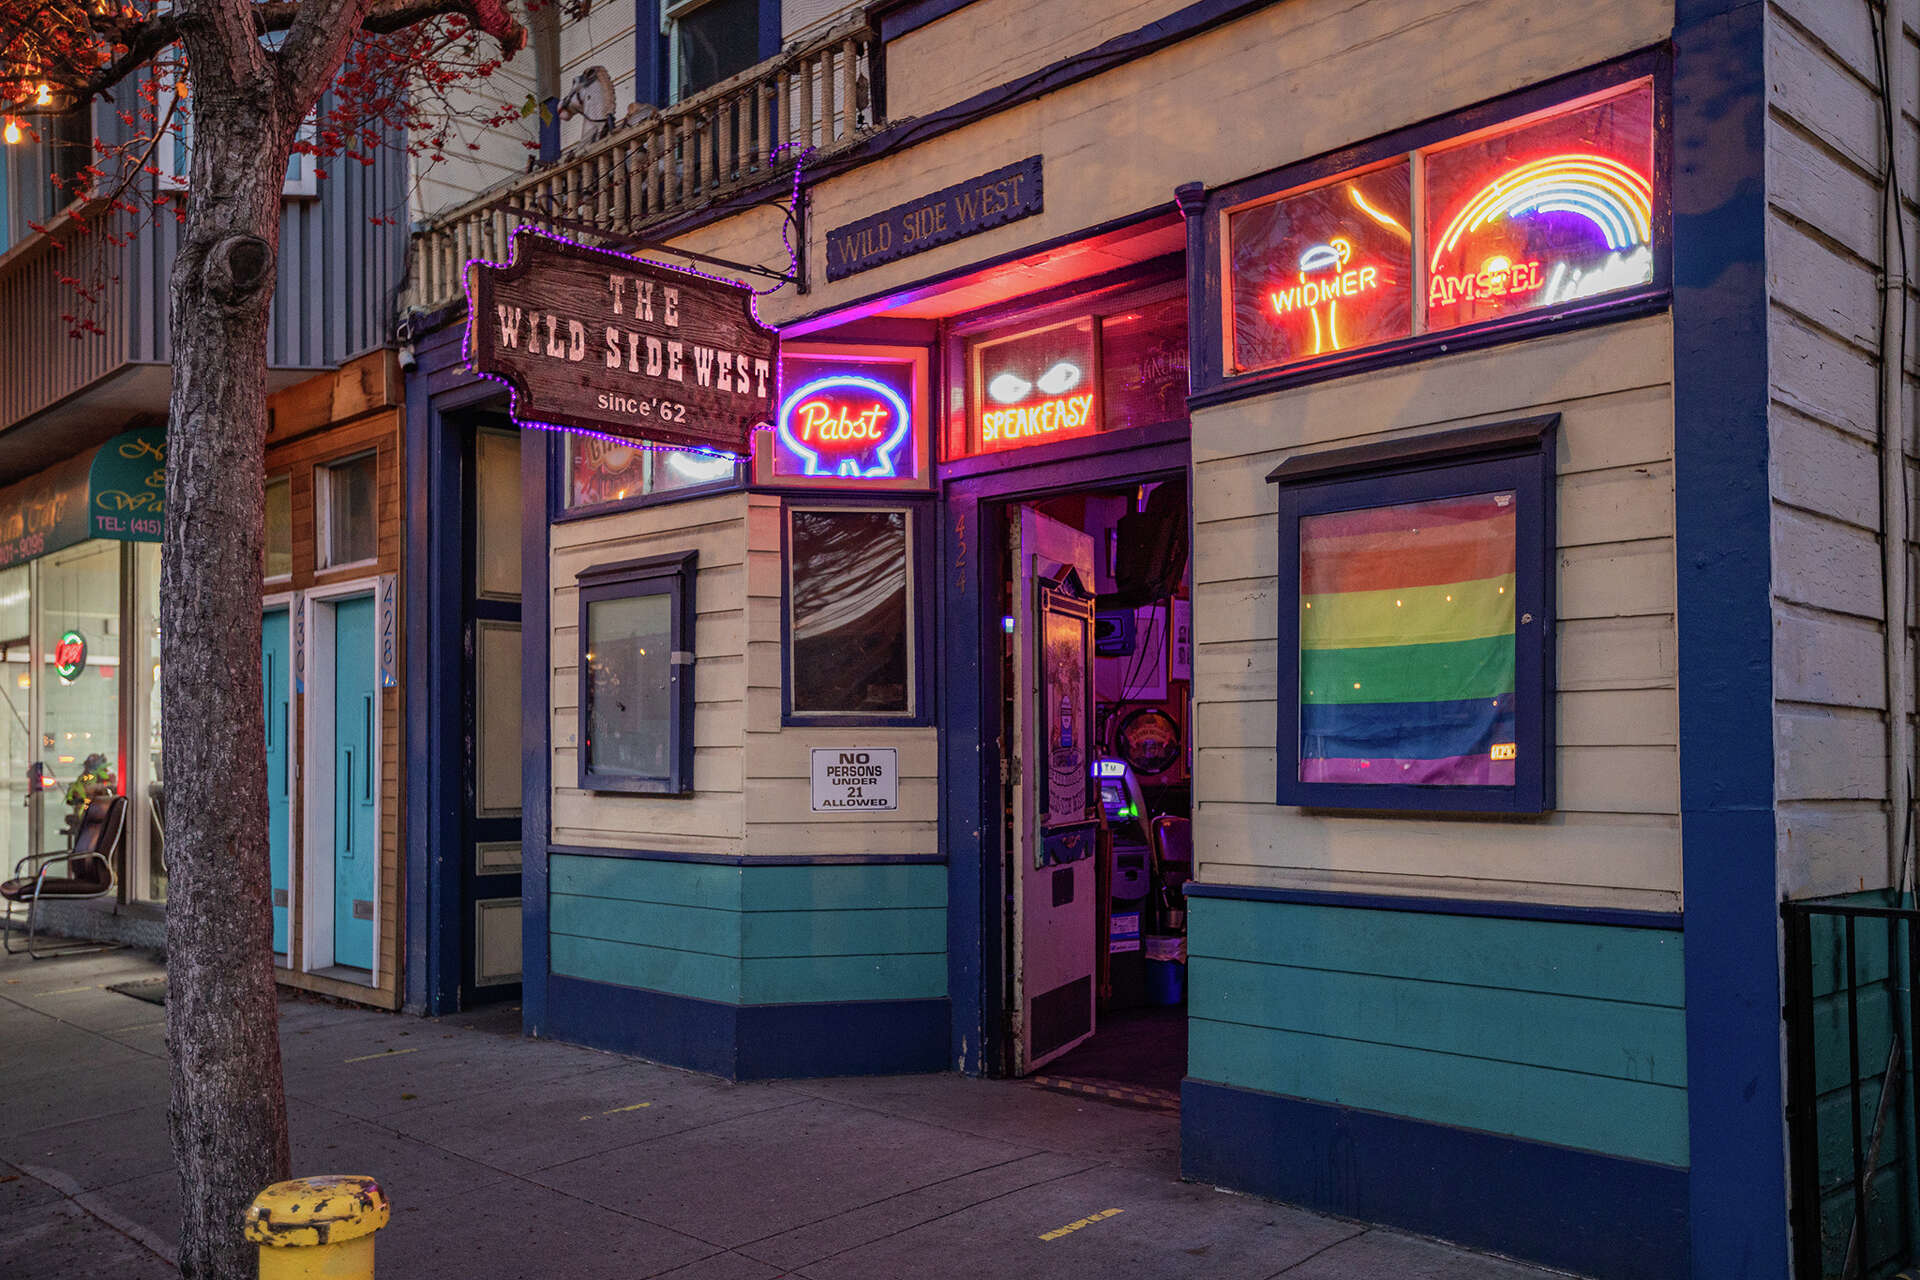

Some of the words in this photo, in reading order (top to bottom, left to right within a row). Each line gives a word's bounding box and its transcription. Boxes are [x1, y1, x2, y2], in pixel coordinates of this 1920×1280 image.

[837, 221, 892, 264] WILD
[902, 203, 948, 244] SIDE
[955, 174, 1024, 225] WEST
[609, 274, 680, 327] THE
[1271, 265, 1377, 315] WIDMER
[1429, 261, 1545, 307] AMSTEL
[497, 303, 586, 362] WILD
[605, 325, 684, 382] SIDE
[693, 345, 770, 399] WEST
[798, 401, 889, 441] Pabst
[982, 393, 1093, 441] SPEAKEASY
[96, 515, 126, 532] TEL:
[130, 517, 161, 536] (415)
[954, 512, 967, 594] 424
[296, 597, 304, 673] 430
[383, 581, 393, 665] 428
[827, 765, 882, 777] PERSONS
[832, 777, 877, 785] UNDER
[839, 753, 870, 765] NO
[822, 798, 888, 807] ALLOWED
[847, 786, 863, 798] 21
